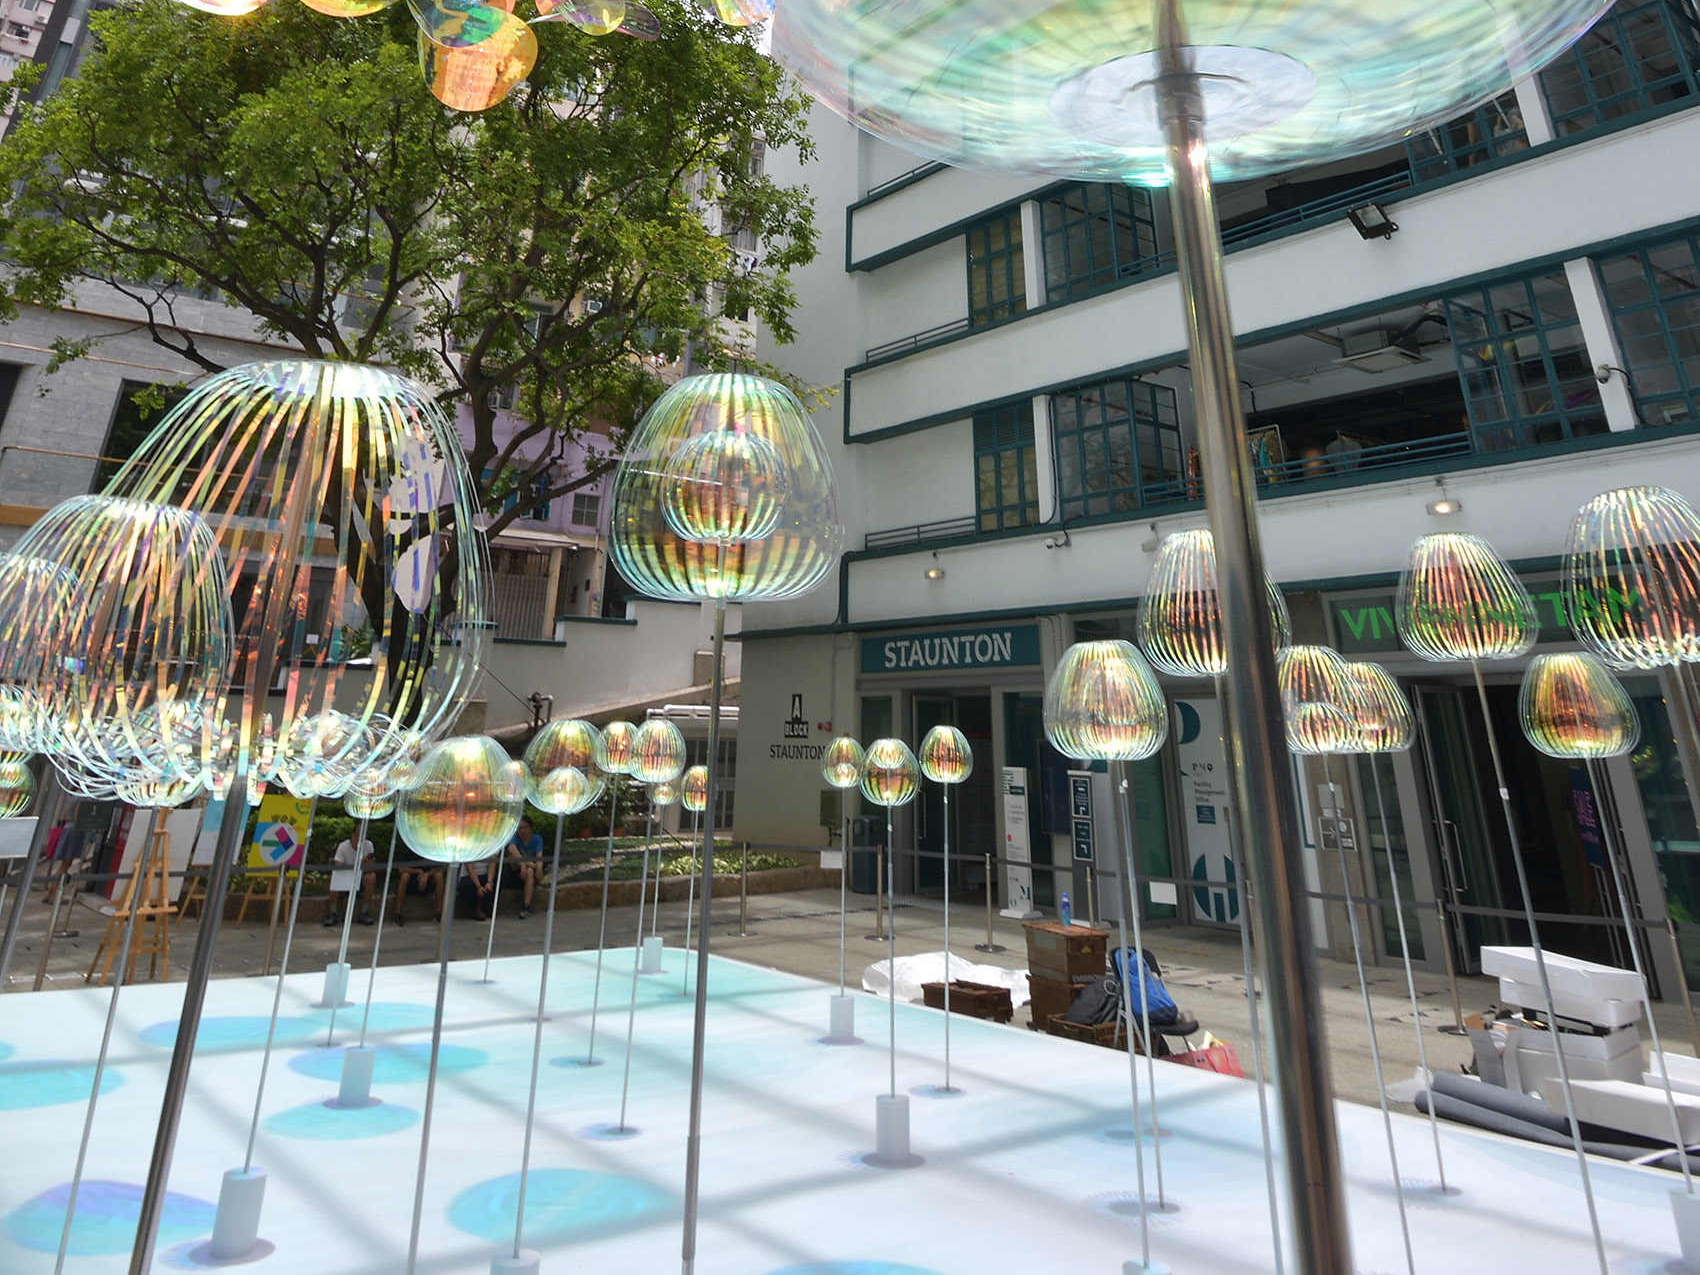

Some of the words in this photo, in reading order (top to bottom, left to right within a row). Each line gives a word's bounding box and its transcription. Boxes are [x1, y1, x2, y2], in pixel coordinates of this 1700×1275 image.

[884, 632, 1012, 668] STAUNTON
[793, 696, 801, 718] A
[785, 723, 808, 736] BLOCK
[769, 744, 827, 760] STAUNTON
